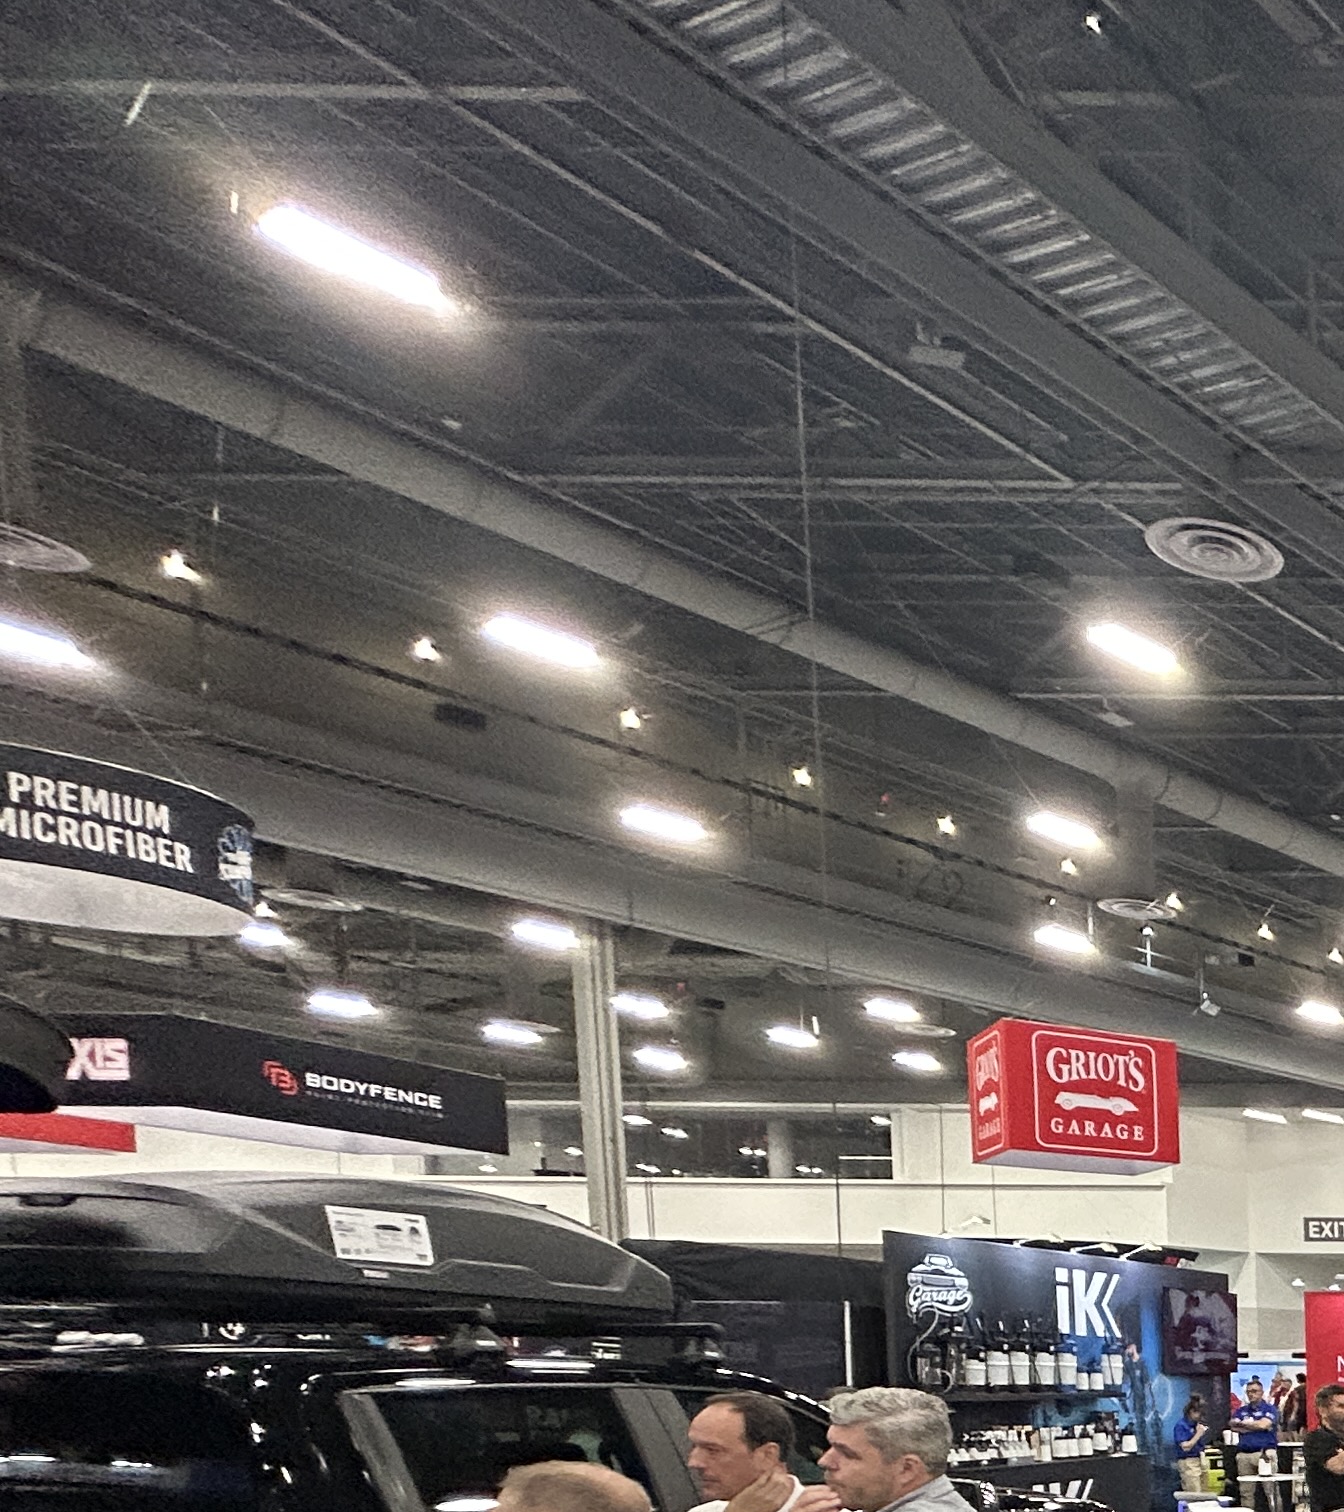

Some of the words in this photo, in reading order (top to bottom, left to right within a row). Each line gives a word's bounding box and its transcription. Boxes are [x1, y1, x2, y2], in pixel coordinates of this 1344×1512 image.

[7, 771, 170, 834] PREMIUM
[0, 807, 194, 873] MICROFIBER
[1046, 1047, 1146, 1092] GRIOT'S
[305, 1072, 443, 1110] BODYFENCE
[1050, 1117, 1144, 1141] GARAGE
[908, 1284, 973, 1314] Garage
